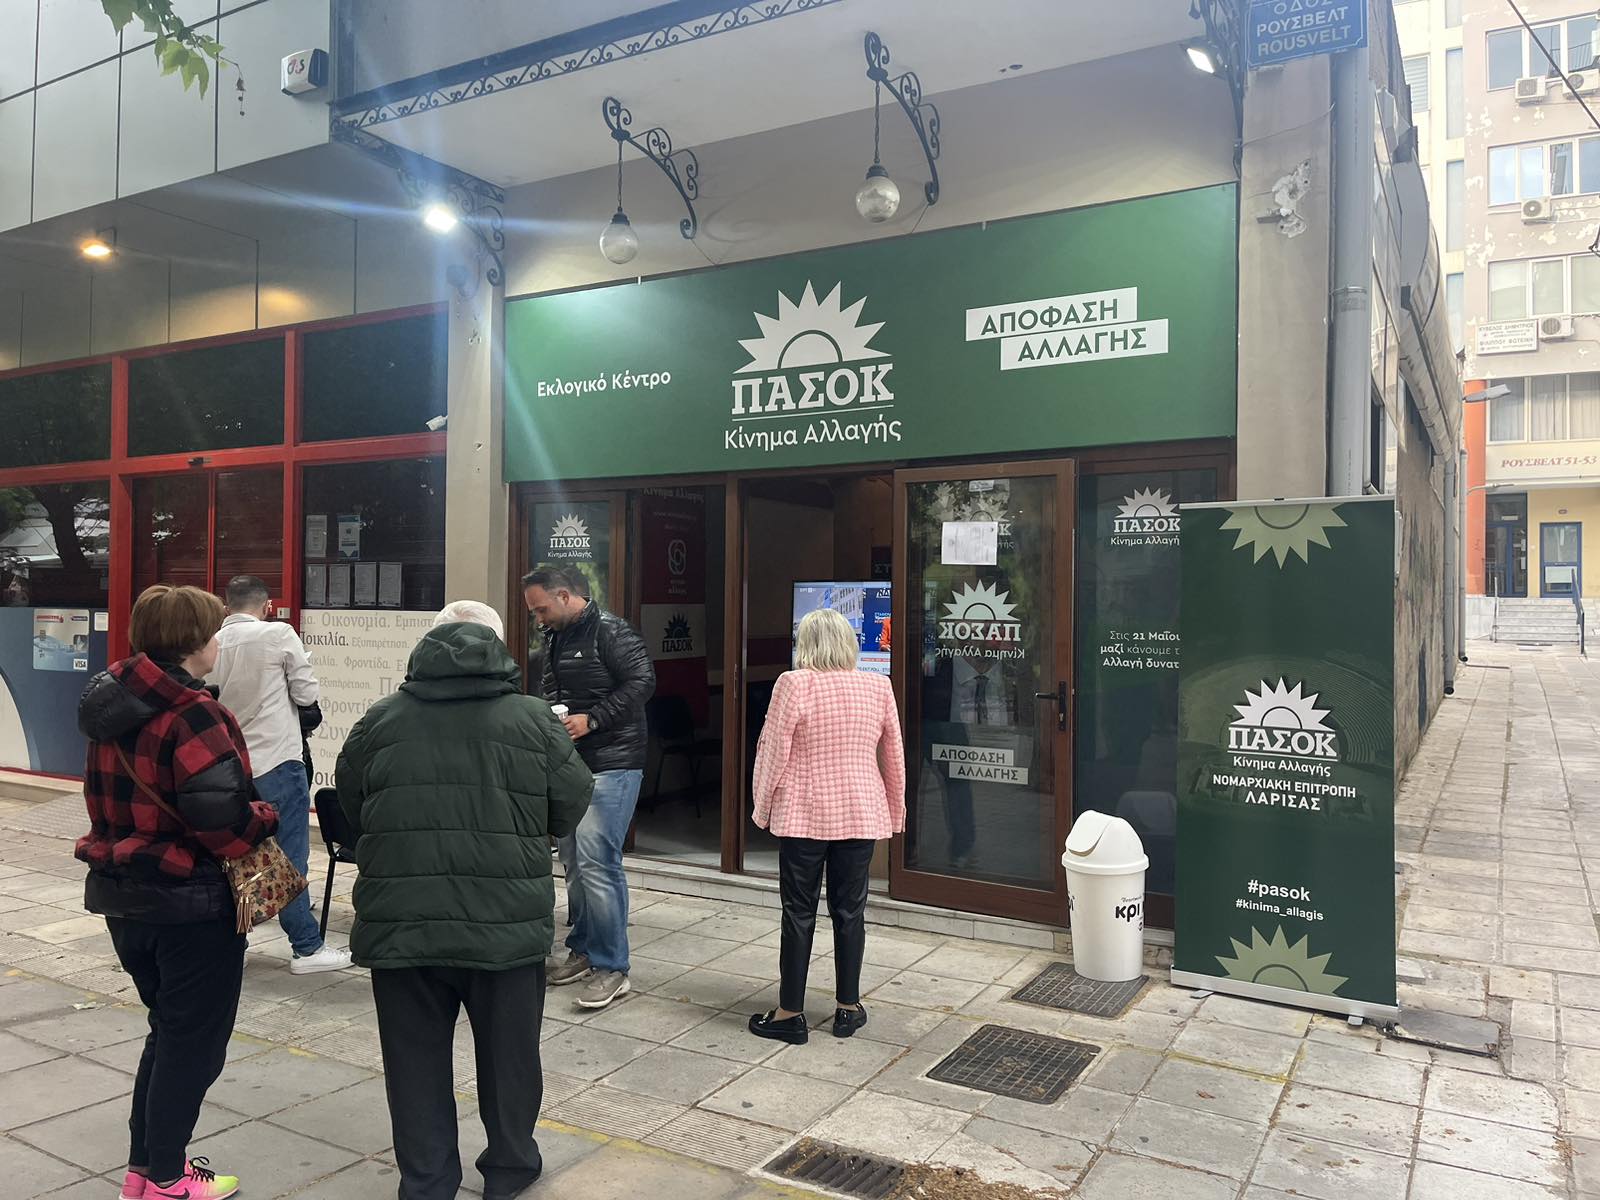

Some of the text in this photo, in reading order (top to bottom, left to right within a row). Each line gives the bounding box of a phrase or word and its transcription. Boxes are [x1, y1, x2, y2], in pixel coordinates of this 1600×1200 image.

[1257, 6, 1349, 37] ΡΟΥΣΒΕΛΤ
[1258, 25, 1351, 56] ROUSVELT
[981, 298, 1118, 336] ΑΠΟΦΑΣΗ
[1017, 327, 1147, 362] ΑΛΛΑΓΗΣ
[537, 370, 672, 397] Εκλογικό Κέντρο
[731, 363, 895, 415] ΠΑΣΟΚ
[724, 413, 902, 452] Κίνημα Αλλαγής
[1564, 455, 1598, 466] 51-53
[1113, 517, 1181, 533] ΠΑΣΟΚ
[549, 537, 591, 548] ΠΑΣΟΚ
[1110, 535, 1143, 547] Κίνημα
[547, 550, 593, 559] Κίνημα Αλλαγής
[321, 611, 391, 632] Οικονομία.
[662, 639, 694, 653] ΠΑΣΟΚ
[1109, 630, 1130, 641] Στις
[1132, 632, 1146, 640] 21
[1100, 643, 1124, 655] μαζί
[1127, 643, 1172, 656] κάνουμε
[1102, 656, 1143, 669] Αλλαγή
[1228, 726, 1338, 757] ΠΑΣΟΚ
[940, 748, 1006, 764] ΑΠΟΦΑΣΗ
[1233, 755, 1332, 778] Κίνημα Αλλαγής
[957, 765, 1019, 781] ΑΛΛΑΓΗΣ
[1213, 774, 1356, 798] ΝΟΜΑΡΧΙΑΚΗ ΕΠΙΤΡΟΠΗ
[1245, 790, 1321, 811] ΛΑΡΙΣΑΣ
[1247, 879, 1311, 902] #pasok
[1235, 898, 1324, 921] #kinima_allagis
